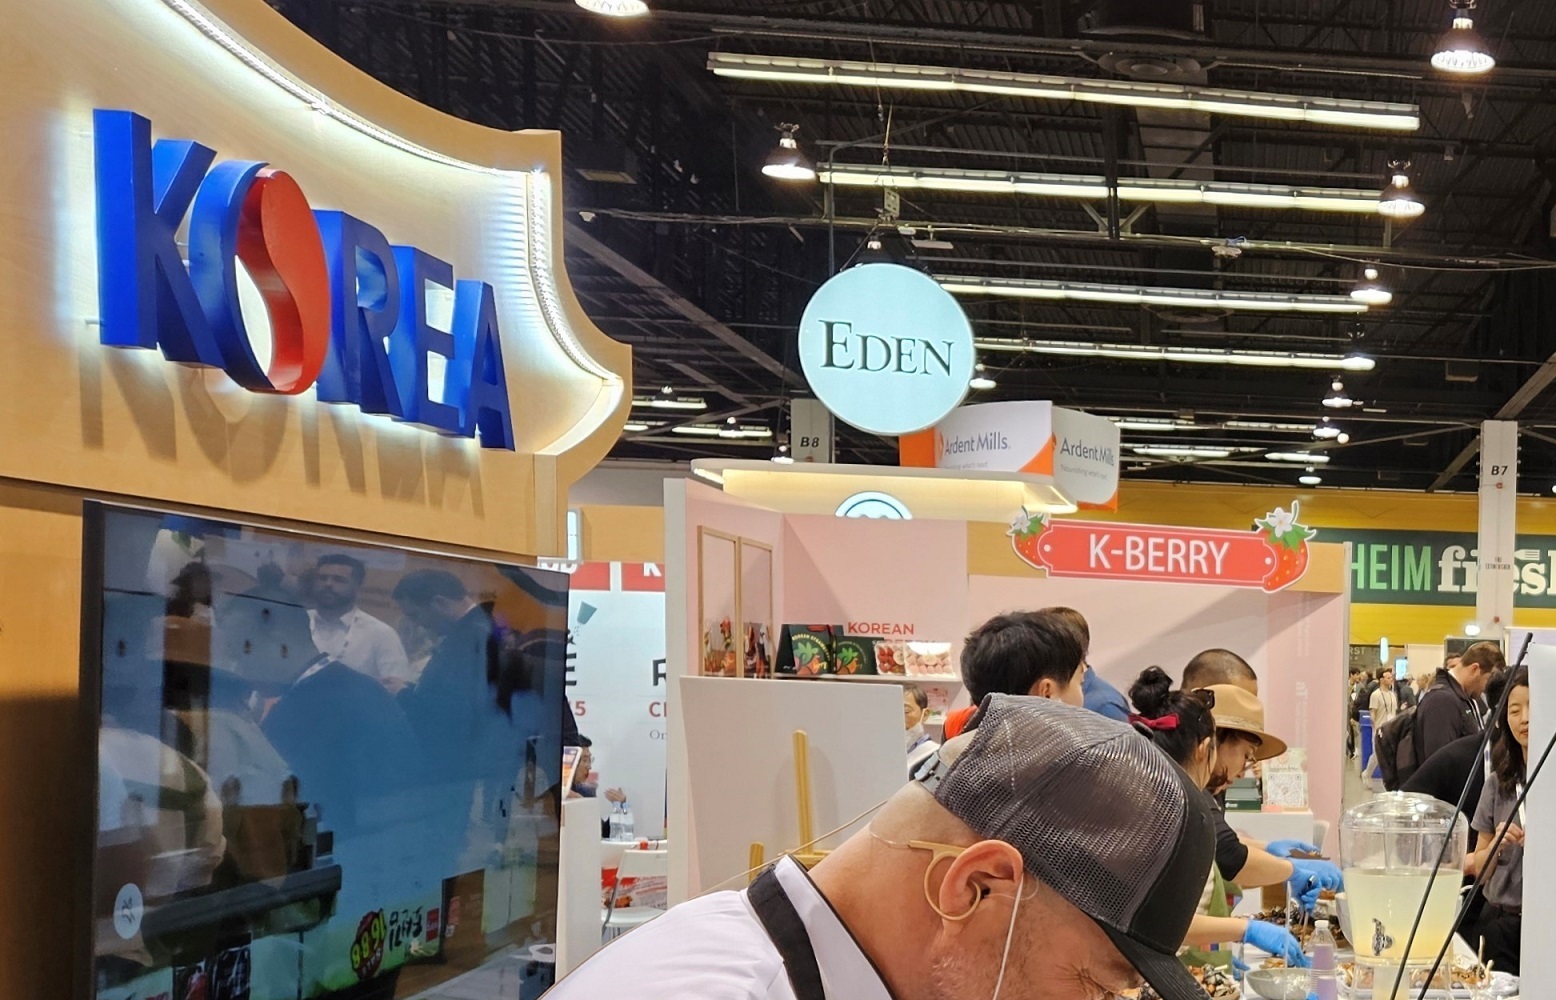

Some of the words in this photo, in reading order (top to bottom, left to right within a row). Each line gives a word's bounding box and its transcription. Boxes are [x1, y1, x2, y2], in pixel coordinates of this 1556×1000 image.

[93, 109, 515, 452] KOREA
[817, 319, 954, 377] EDEN
[943, 434, 975, 456] Ardent
[977, 431, 1009, 452] Mills
[1059, 437, 1099, 461] Ardent
[1099, 446, 1115, 467] Mills
[1491, 465, 1508, 476] B7
[1088, 533, 1231, 576] K-BERRY
[847, 622, 914, 635] KOREAN
